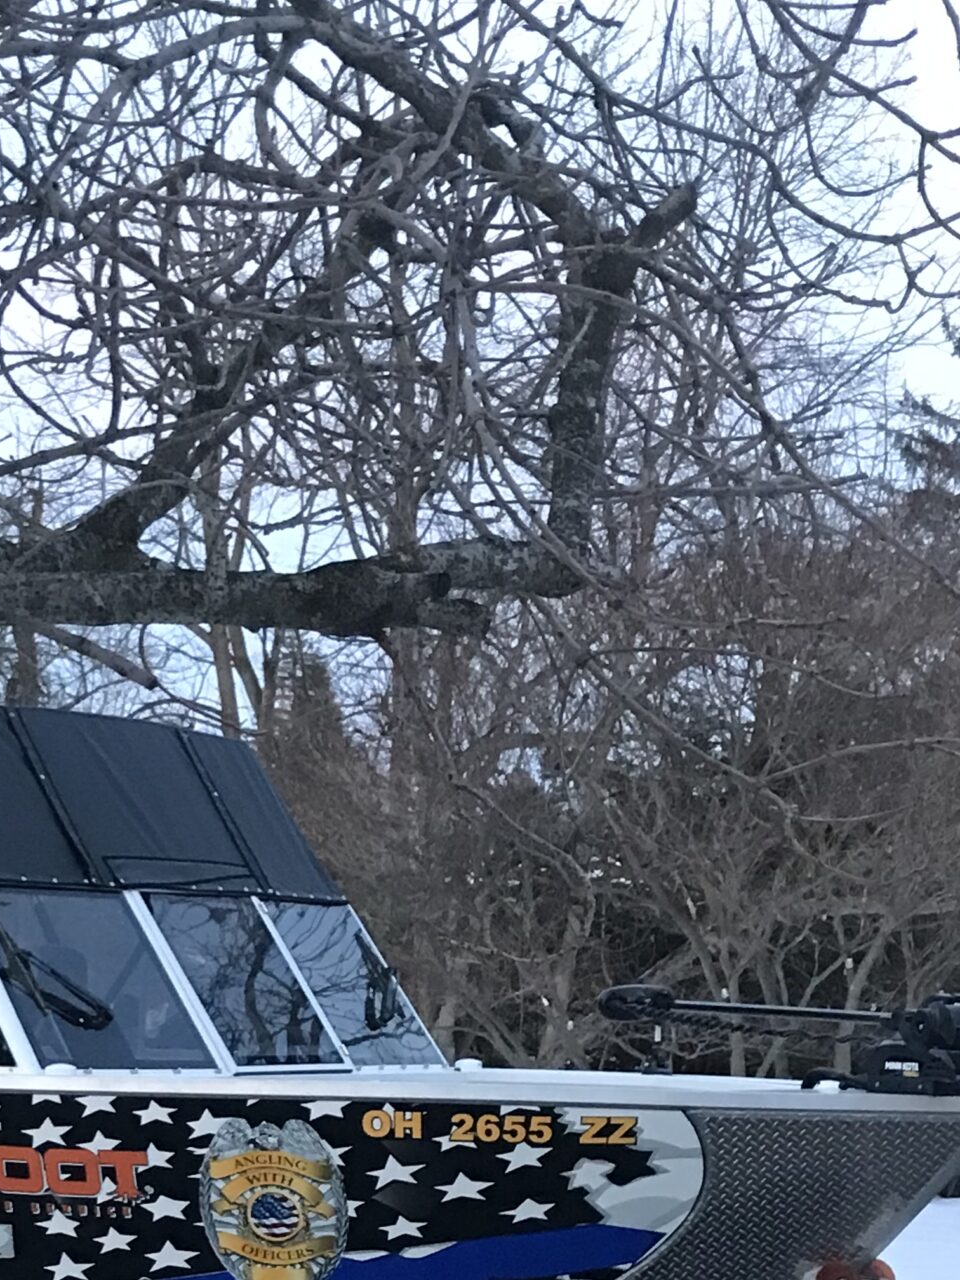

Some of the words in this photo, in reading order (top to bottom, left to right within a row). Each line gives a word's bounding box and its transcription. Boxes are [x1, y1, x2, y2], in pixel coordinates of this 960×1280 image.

[361, 1109, 422, 1140] OH
[449, 1113, 553, 1144] 2655
[579, 1116, 638, 1145] ZZ
[234, 1153, 308, 1172] ANGLING
[245, 1172, 294, 1187] WITH
[241, 1243, 314, 1260] OFFICERS
